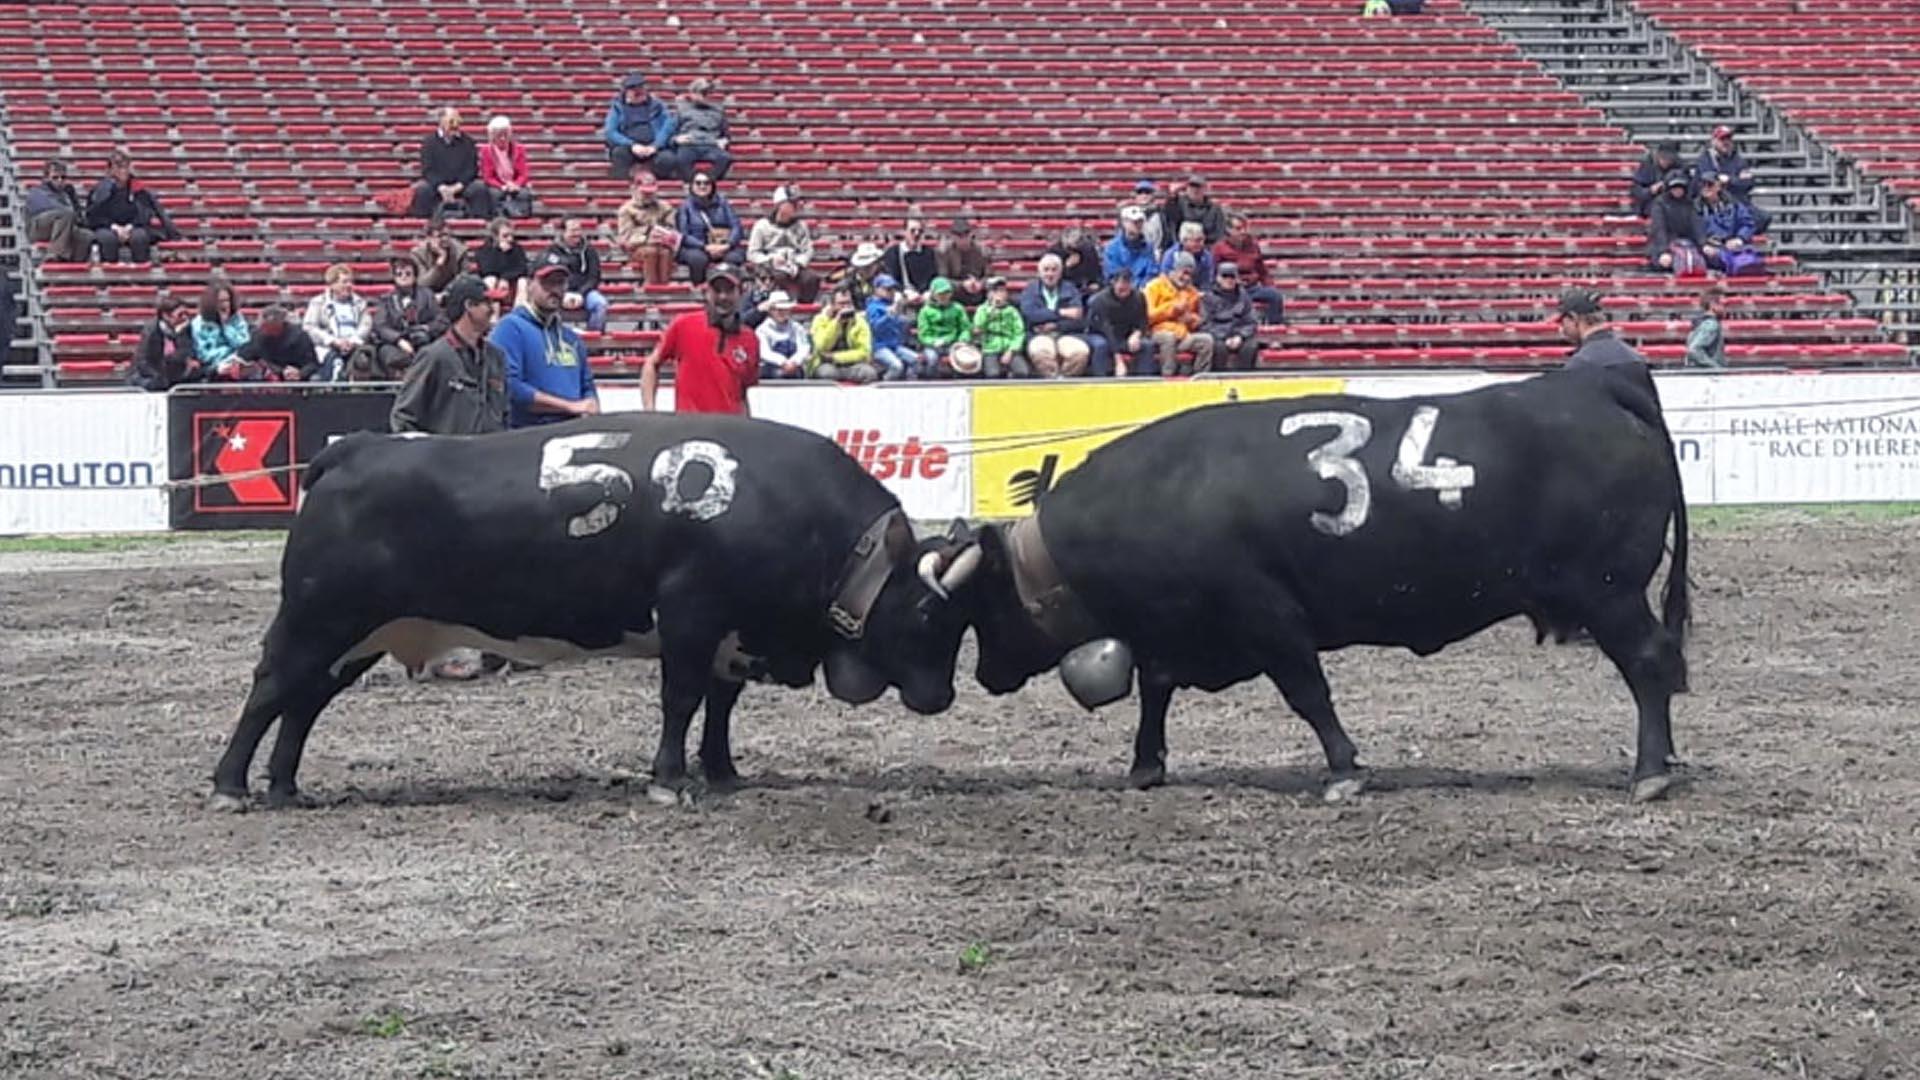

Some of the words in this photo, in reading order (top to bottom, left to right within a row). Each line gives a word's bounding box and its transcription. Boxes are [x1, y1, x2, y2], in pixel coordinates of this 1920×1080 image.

[1730, 418, 1807, 436] FINALE
[1815, 416, 1920, 435] NATIONA
[1768, 439, 1825, 457] RACE
[539, 432, 739, 537] 50
[1280, 406, 1475, 536] 34
